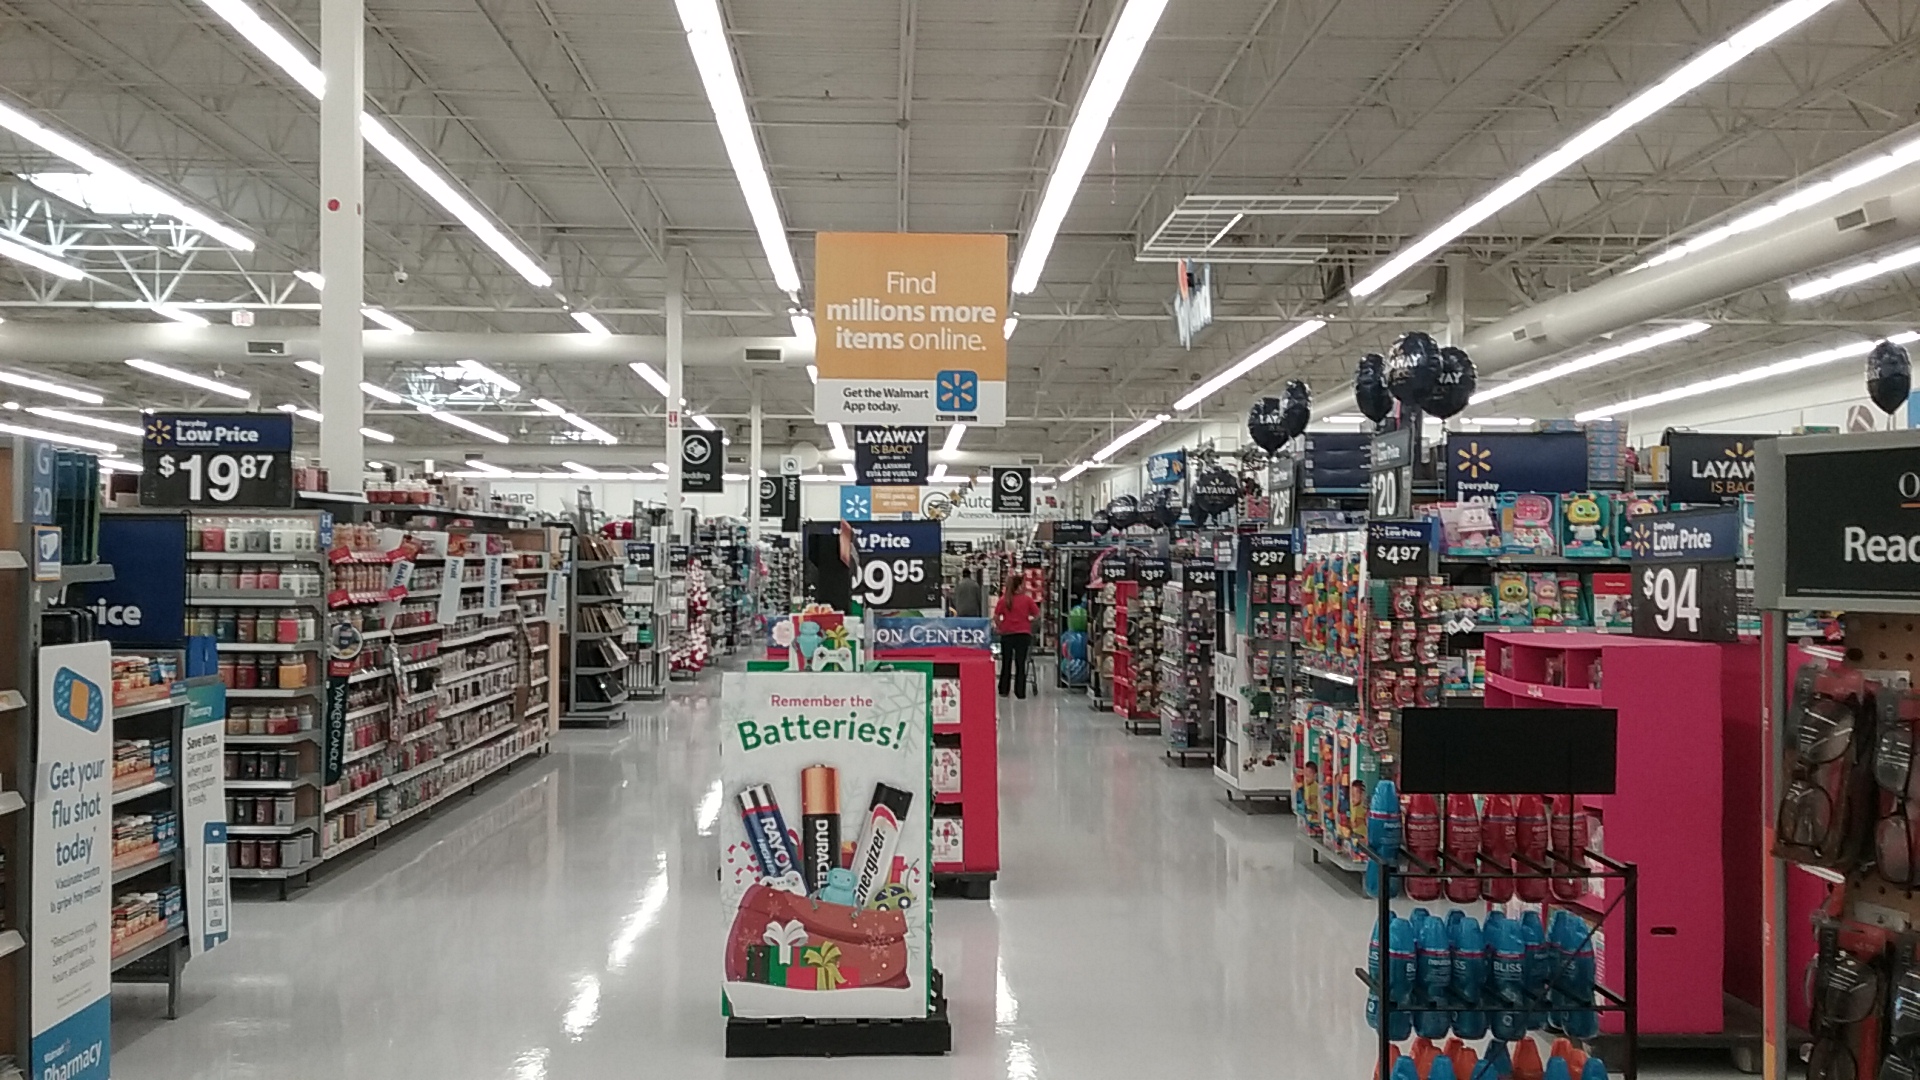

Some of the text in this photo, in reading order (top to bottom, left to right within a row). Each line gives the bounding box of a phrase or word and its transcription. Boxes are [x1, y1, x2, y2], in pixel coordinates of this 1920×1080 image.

[887, 271, 936, 294] Find
[827, 298, 996, 323] millions more
[836, 326, 987, 350] items online.
[843, 387, 929, 399] Get the Walmart
[843, 401, 901, 413] App today.
[176, 420, 207, 428] Everyday
[176, 426, 259, 442] Low Price
[857, 430, 926, 444] LAYAWAY
[871, 445, 912, 454] IS BACK!
[37, 443, 49, 474] G
[788, 477, 797, 501] Home
[1196, 485, 1237, 495] LAYAWAY
[1372, 471, 1396, 516] $20
[1457, 481, 1499, 491] Everyday
[1711, 481, 1723, 493] IS
[35, 487, 51, 515] 20
[322, 514, 332, 528] H
[1653, 522, 1675, 531] Everyday
[870, 533, 911, 548] Price
[1402, 529, 1422, 537] Price
[1653, 527, 1712, 551] Low Price
[1643, 567, 1700, 633] $94
[909, 625, 985, 644] CENTER
[771, 695, 873, 707] Remember the
[737, 712, 906, 751] Batteries!
[186, 737, 202, 750] Save
[50, 759, 105, 793] Get your
[52, 791, 101, 830] flu shot
[1494, 962, 1521, 972] BLISS
[44, 1040, 102, 1080] Pharmacy
